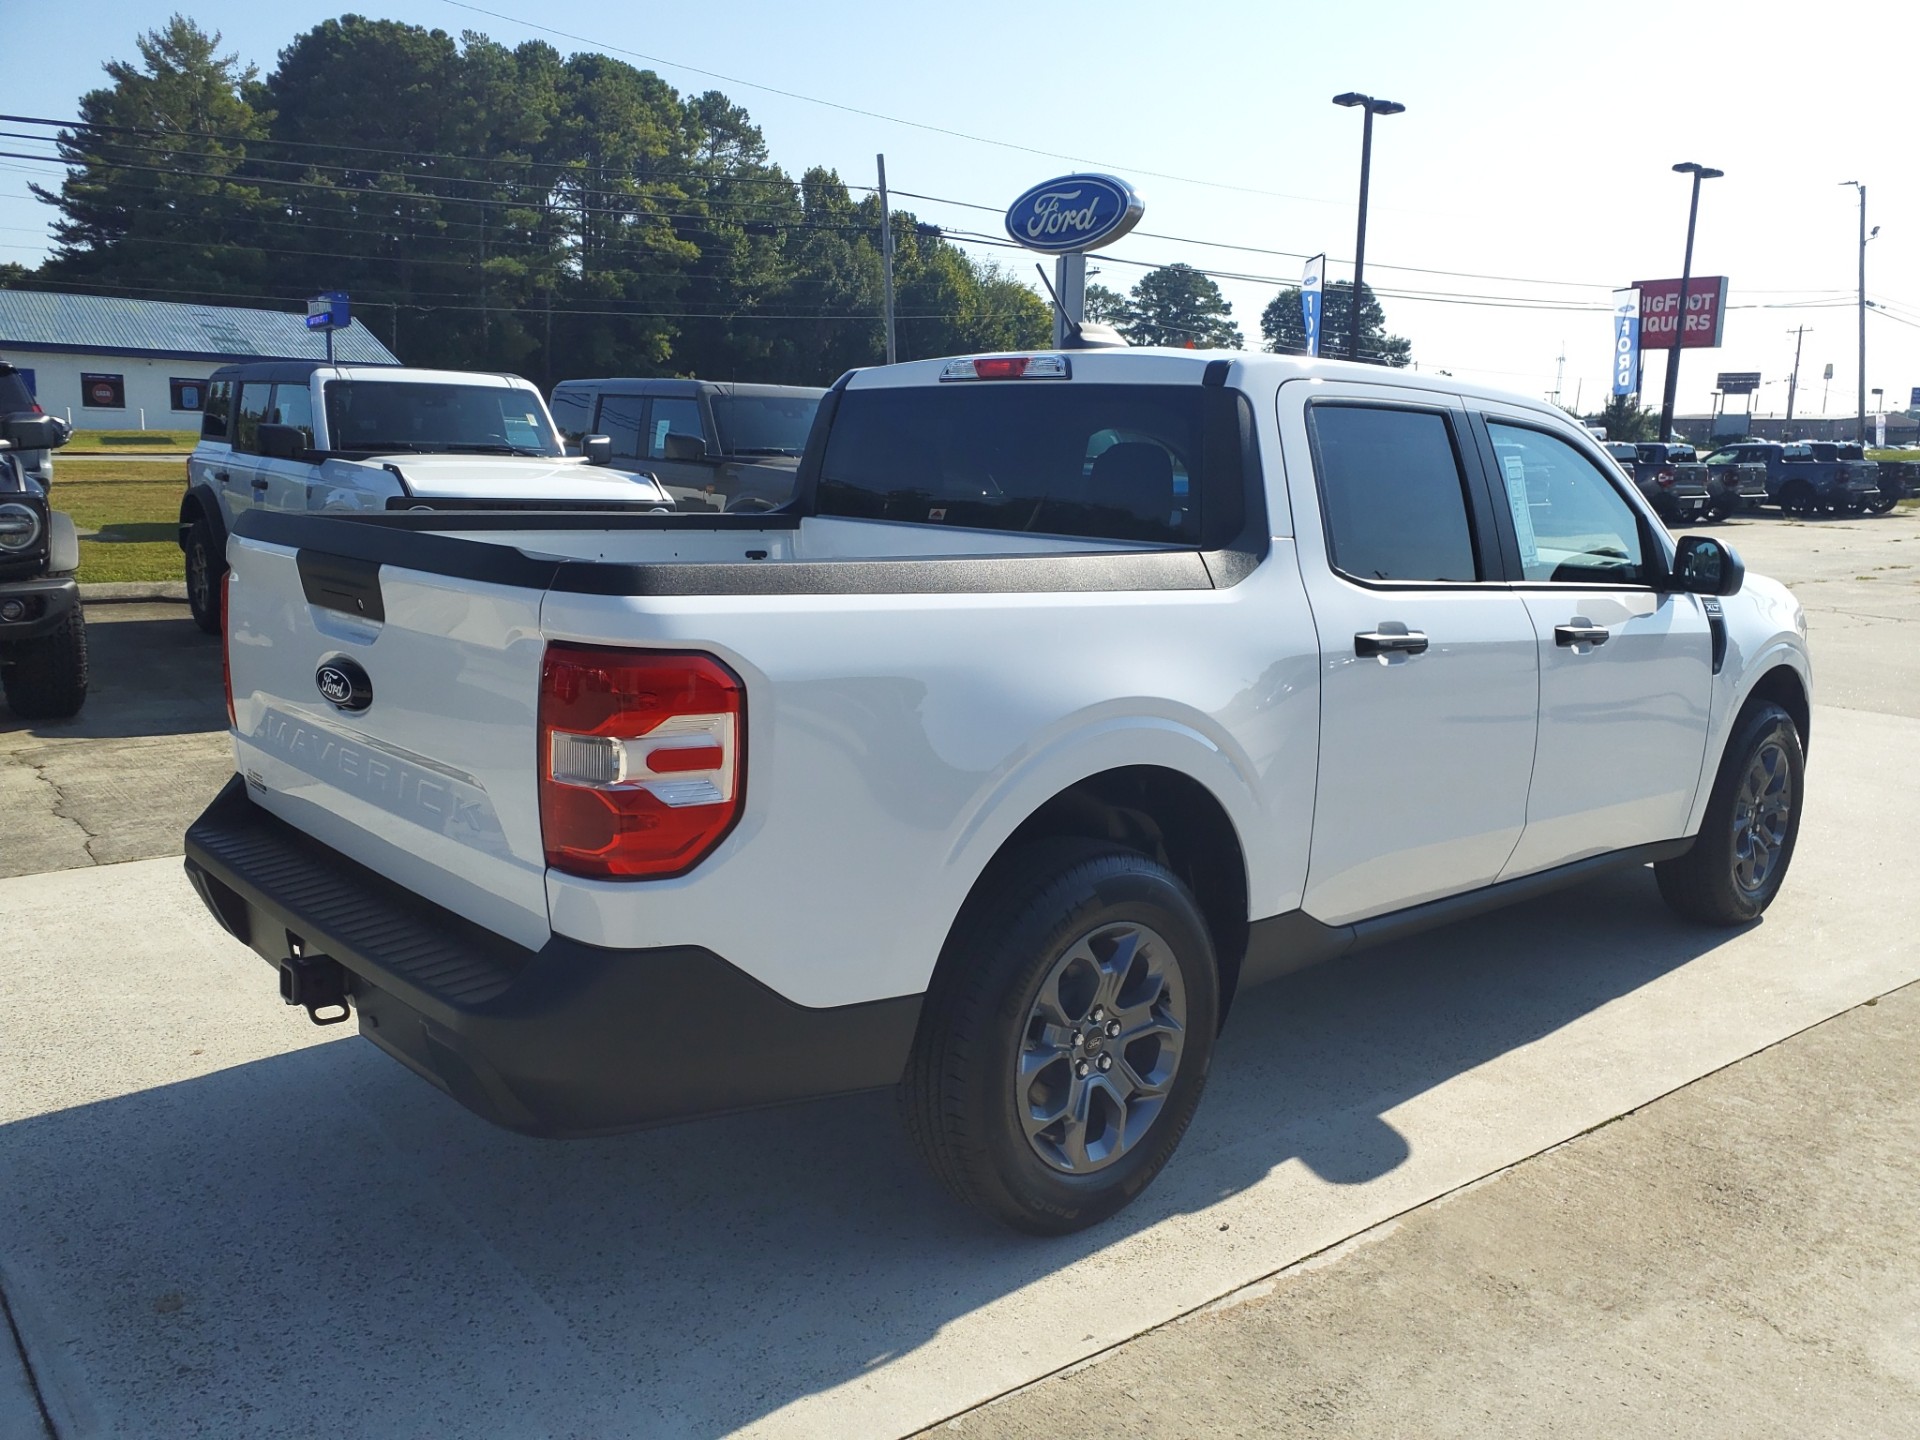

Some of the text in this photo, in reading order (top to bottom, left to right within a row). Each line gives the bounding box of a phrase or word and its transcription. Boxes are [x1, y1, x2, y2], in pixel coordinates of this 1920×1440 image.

[1027, 189, 1099, 237] Ford
[1642, 292, 1715, 313] IGFOT
[1642, 314, 1710, 333] IQURS
[321, 670, 344, 697] Ford
[265, 715, 482, 831] MAVERICK
